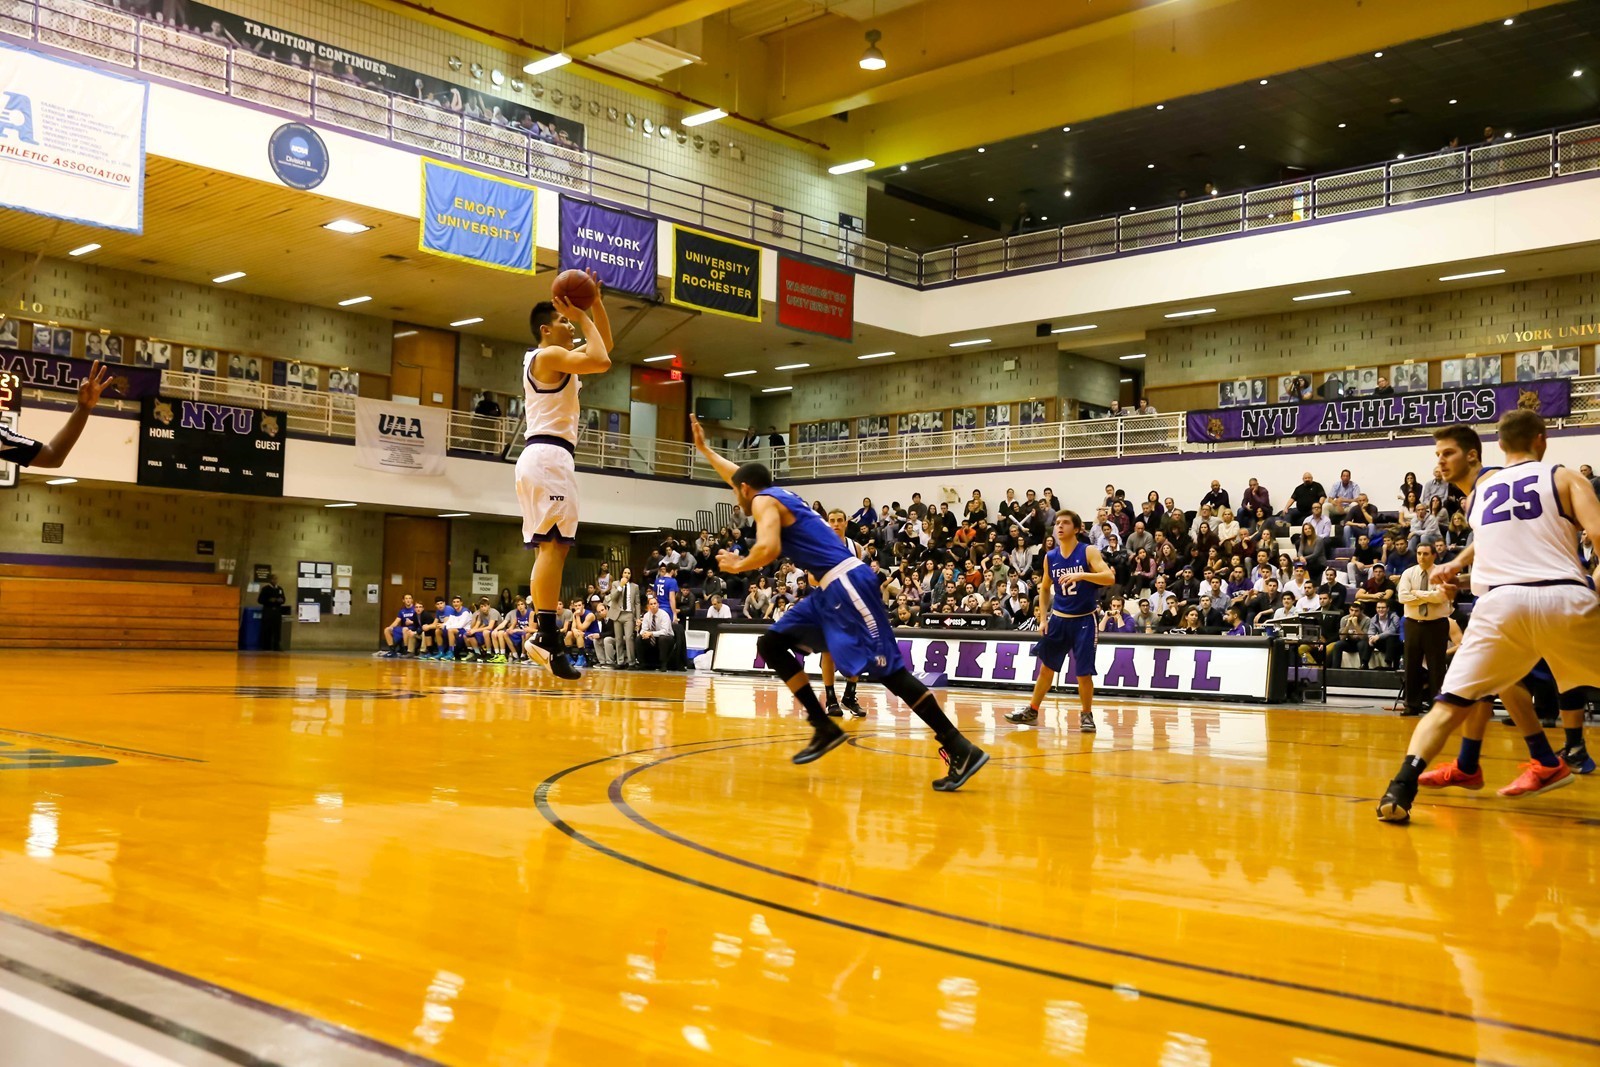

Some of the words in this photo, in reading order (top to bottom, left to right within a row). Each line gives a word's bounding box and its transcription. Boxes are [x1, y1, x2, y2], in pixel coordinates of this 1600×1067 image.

[244, 21, 315, 54] TRADITION
[317, 40, 396, 78] CONTINUES...
[53, 158, 131, 183] ASSOCIATION
[454, 197, 508, 220] EMORY
[437, 213, 522, 244] UNIVERSITY
[577, 227, 606, 245] NEW
[607, 233, 641, 252] YORK
[572, 245, 645, 271] UNIVERSITY
[685, 249, 751, 277] UNIVERSITY
[682, 274, 752, 300] ROCHESTER
[710, 269, 726, 280] OF
[786, 279, 847, 304] WASHINGTON
[786, 294, 844, 317] UNIVERSITY
[1514, 328, 1553, 343] YORK
[1559, 322, 1600, 339] UNIV
[181, 401, 254, 435] NYU
[1240, 406, 1299, 438] NYU
[1319, 388, 1496, 432] ATHLETICS
[149, 427, 175, 439] HOME
[378, 413, 424, 439] UAA
[255, 440, 281, 451] GUEST
[1481, 475, 1543, 526] 25
[656, 584, 665, 596] 15
[1061, 580, 1077, 596] 12
